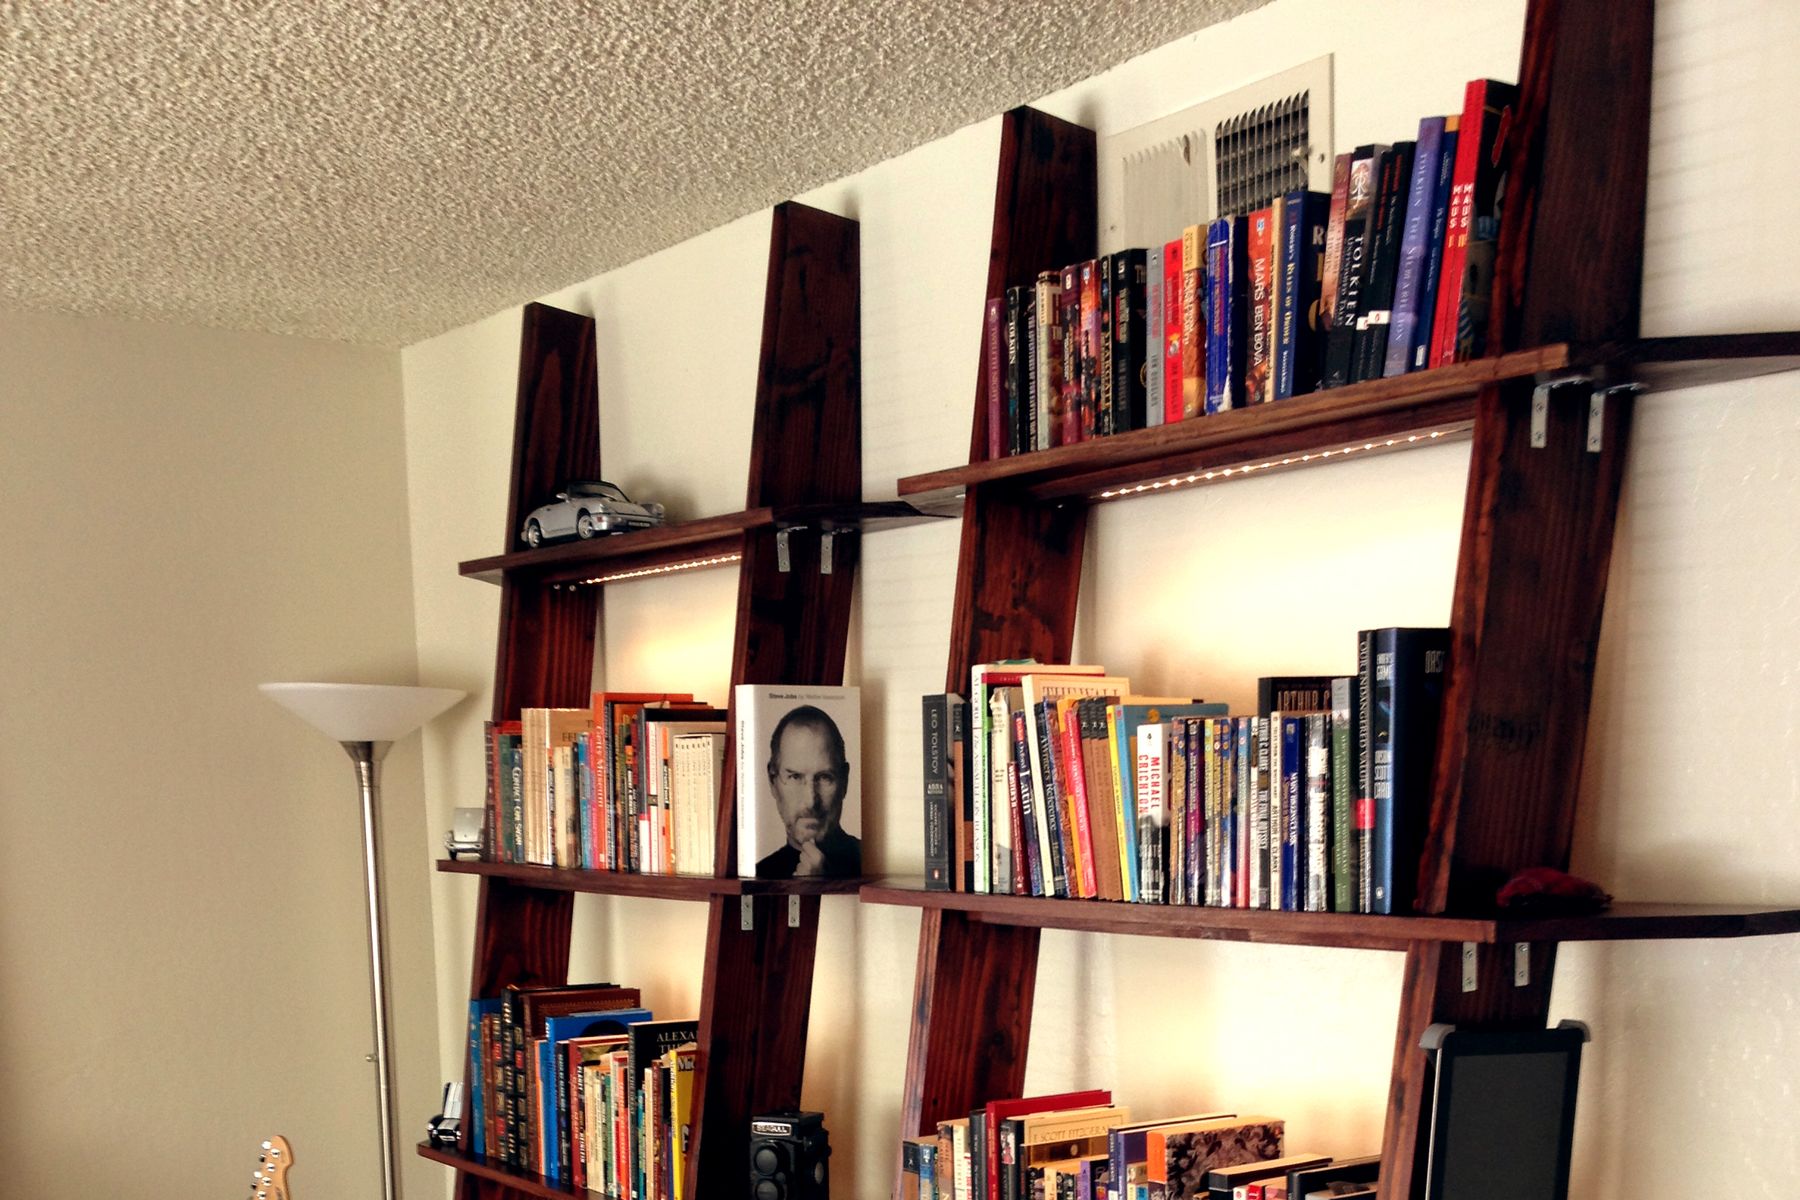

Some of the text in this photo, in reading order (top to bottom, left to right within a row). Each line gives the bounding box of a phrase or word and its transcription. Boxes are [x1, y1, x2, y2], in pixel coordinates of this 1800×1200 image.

[1449, 183, 1464, 228] MAUS
[1460, 183, 1475, 228] MAUS
[1345, 235, 1365, 327] TOLKIEN
[1253, 257, 1265, 366] MARS BEN BOVA
[1008, 321, 1017, 365] TOLKIEN
[930, 708, 938, 775] LEO TOLSTOY
[596, 759, 605, 807] Museum
[1018, 769, 1033, 815] Latin
[1138, 755, 1149, 816] CRICHTON
[1151, 757, 1161, 809] MICHAEL
[657, 1031, 698, 1042] ALEXA
